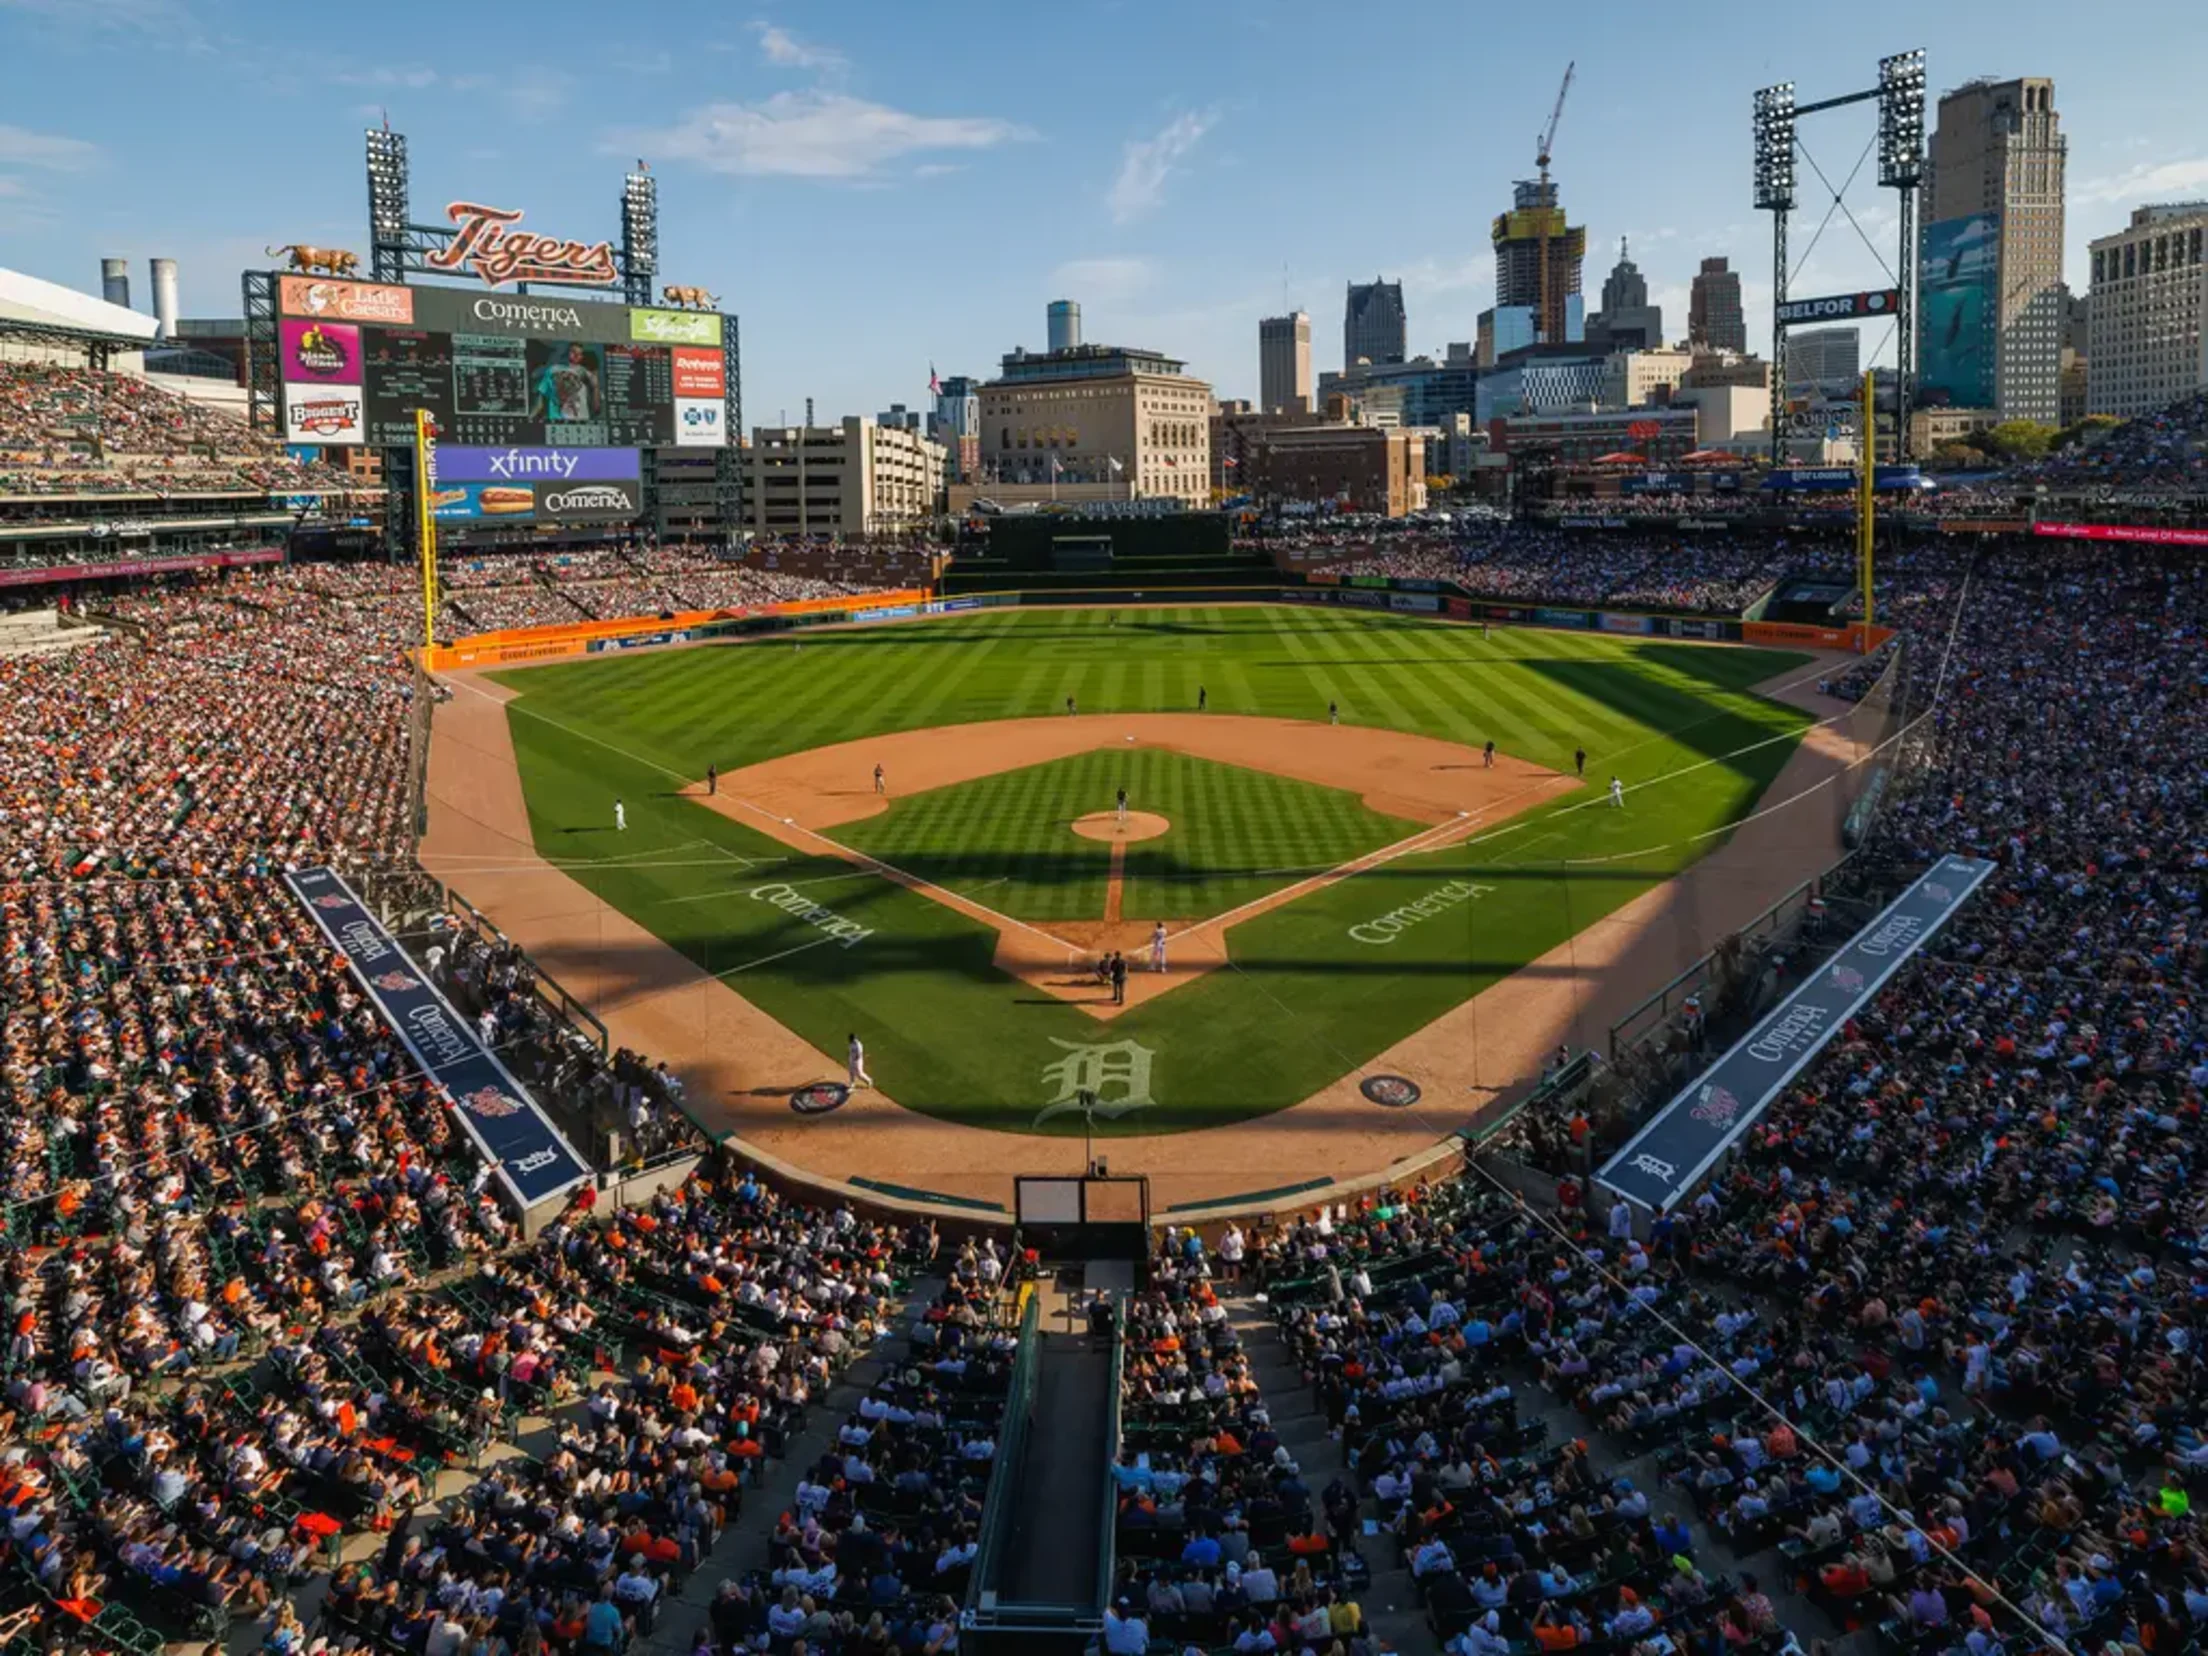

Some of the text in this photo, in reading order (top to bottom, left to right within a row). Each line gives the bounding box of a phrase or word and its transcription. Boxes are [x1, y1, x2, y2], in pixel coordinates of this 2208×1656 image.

[424, 200, 618, 289] Tigers
[1777, 298, 1853, 320] BELFOR
[506, 320, 556, 331] PARK
[489, 448, 579, 479] xfinity
